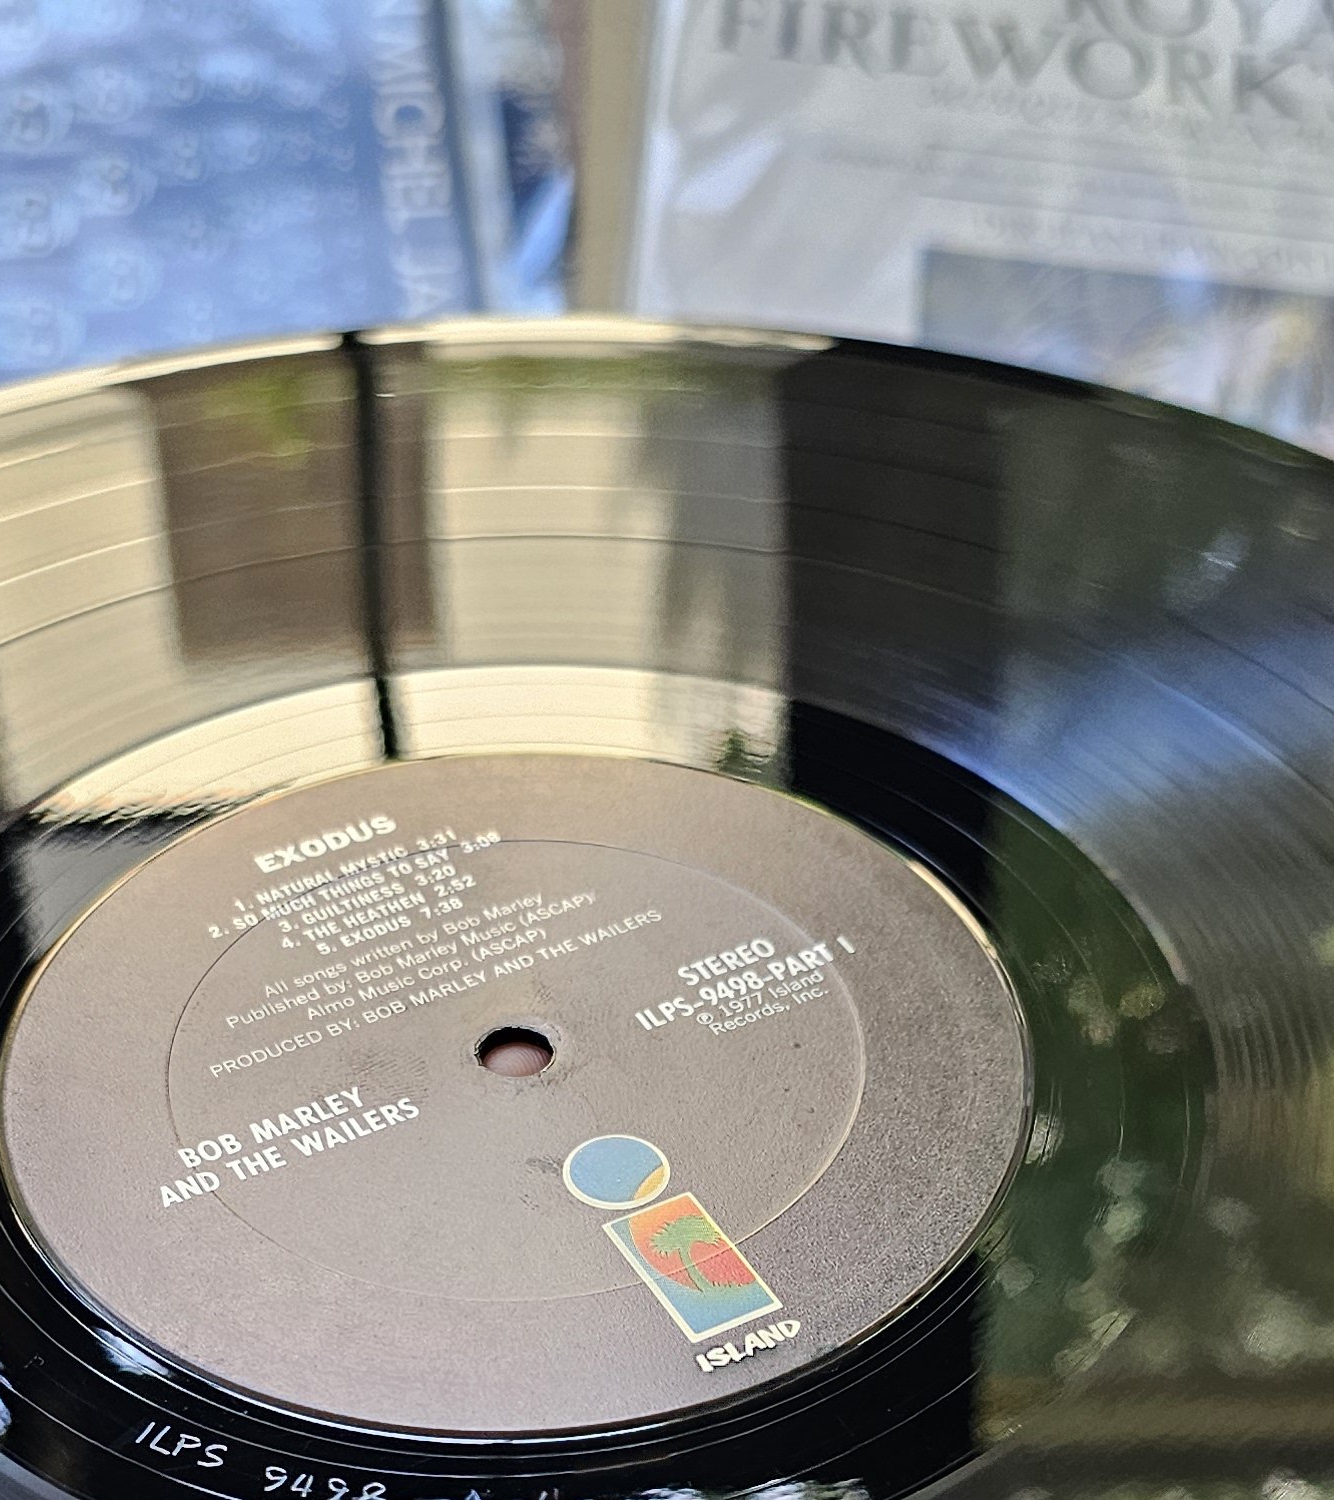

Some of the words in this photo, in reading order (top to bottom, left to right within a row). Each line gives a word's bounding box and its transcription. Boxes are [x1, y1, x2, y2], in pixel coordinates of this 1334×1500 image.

[235, 899, 254, 912] 1.
[256, 869, 334, 905] NATURAL
[339, 847, 408, 877] MYSTIC
[416, 827, 458, 851] 3:31
[253, 816, 397, 873] EXODUS
[208, 925, 230, 939] 2.
[233, 913, 258, 930] SO
[261, 895, 317, 921] MUCH
[318, 873, 386, 901] THINGS
[387, 862, 413, 879] TO
[414, 849, 450, 869] SAY
[278, 919, 298, 933] 3.
[301, 883, 406, 926] GUILTINESS
[415, 865, 457, 888] 3:20
[281, 936, 301, 950] 4.
[303, 922, 342, 943] THE
[344, 893, 427, 929] HEATHEN
[434, 874, 477, 898] 2:52
[317, 941, 338, 956] 5.
[340, 916, 412, 948] EXODUS
[420, 898, 464, 920] 7:38
[226, 988, 321, 1030] Published
[324, 976, 352, 998] by:
[356, 962, 394, 987] Bob
[396, 938, 460, 969] Marley
[461, 922, 517, 949] Music
[263, 983, 290, 1000] All
[293, 960, 348, 993] songs
[350, 937, 414, 969] written
[416, 926, 440, 947] by
[442, 914, 481, 937] Bob
[482, 892, 543, 924] Marley
[306, 997, 356, 1021] Almo
[358, 973, 414, 1003] Music
[417, 957, 469, 988] Corp.
[472, 927, 547, 964] (ASCAP)
[677, 938, 776, 986] STEREO
[209, 1030, 323, 1080] PRODUCED
[329, 1017, 361, 1039] BY:
[362, 998, 407, 1025] BOB
[410, 970, 488, 1007] MARLEY
[493, 954, 535, 980] AND
[539, 938, 578, 962] THE
[577, 909, 663, 947] WAILERS
[708, 999, 791, 1036] Records,
[791, 984, 829, 1005] Inc.
[718, 991, 764, 1018] 1977
[768, 971, 824, 999] Island
[160, 1171, 220, 1208] AND
[225, 1146, 287, 1181] THE
[290, 1097, 420, 1157] WAILERS
[177, 1133, 243, 1169] BOB
[249, 1086, 364, 1144] MARLEY
[695, 1319, 801, 1373] ISLAND
[134, 1421, 229, 1469] ILPS
